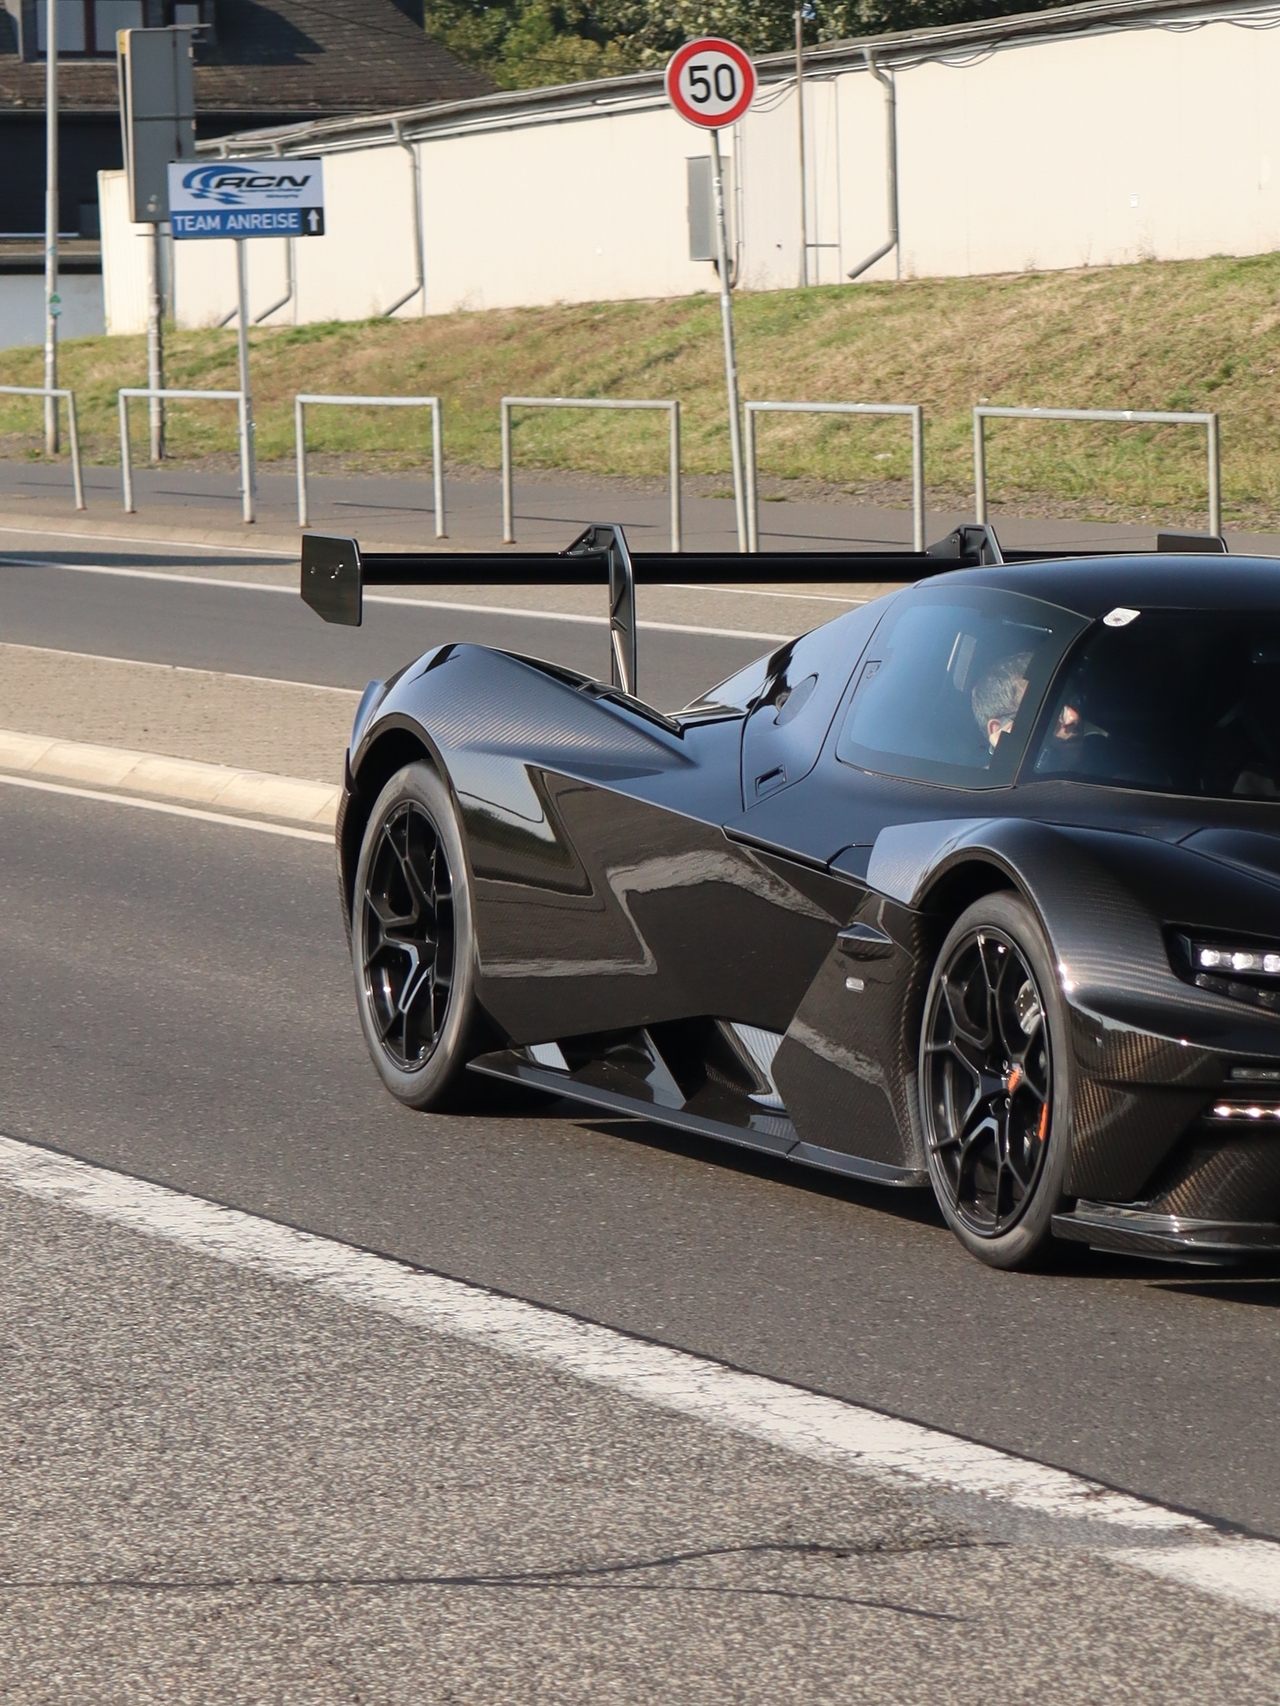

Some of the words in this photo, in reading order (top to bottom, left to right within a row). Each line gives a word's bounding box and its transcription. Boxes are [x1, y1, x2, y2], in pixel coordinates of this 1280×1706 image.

[688, 63, 736, 103] 50
[214, 175, 311, 189] RCN
[174, 215, 221, 231] TEAM
[226, 212, 299, 230] ANREISE
